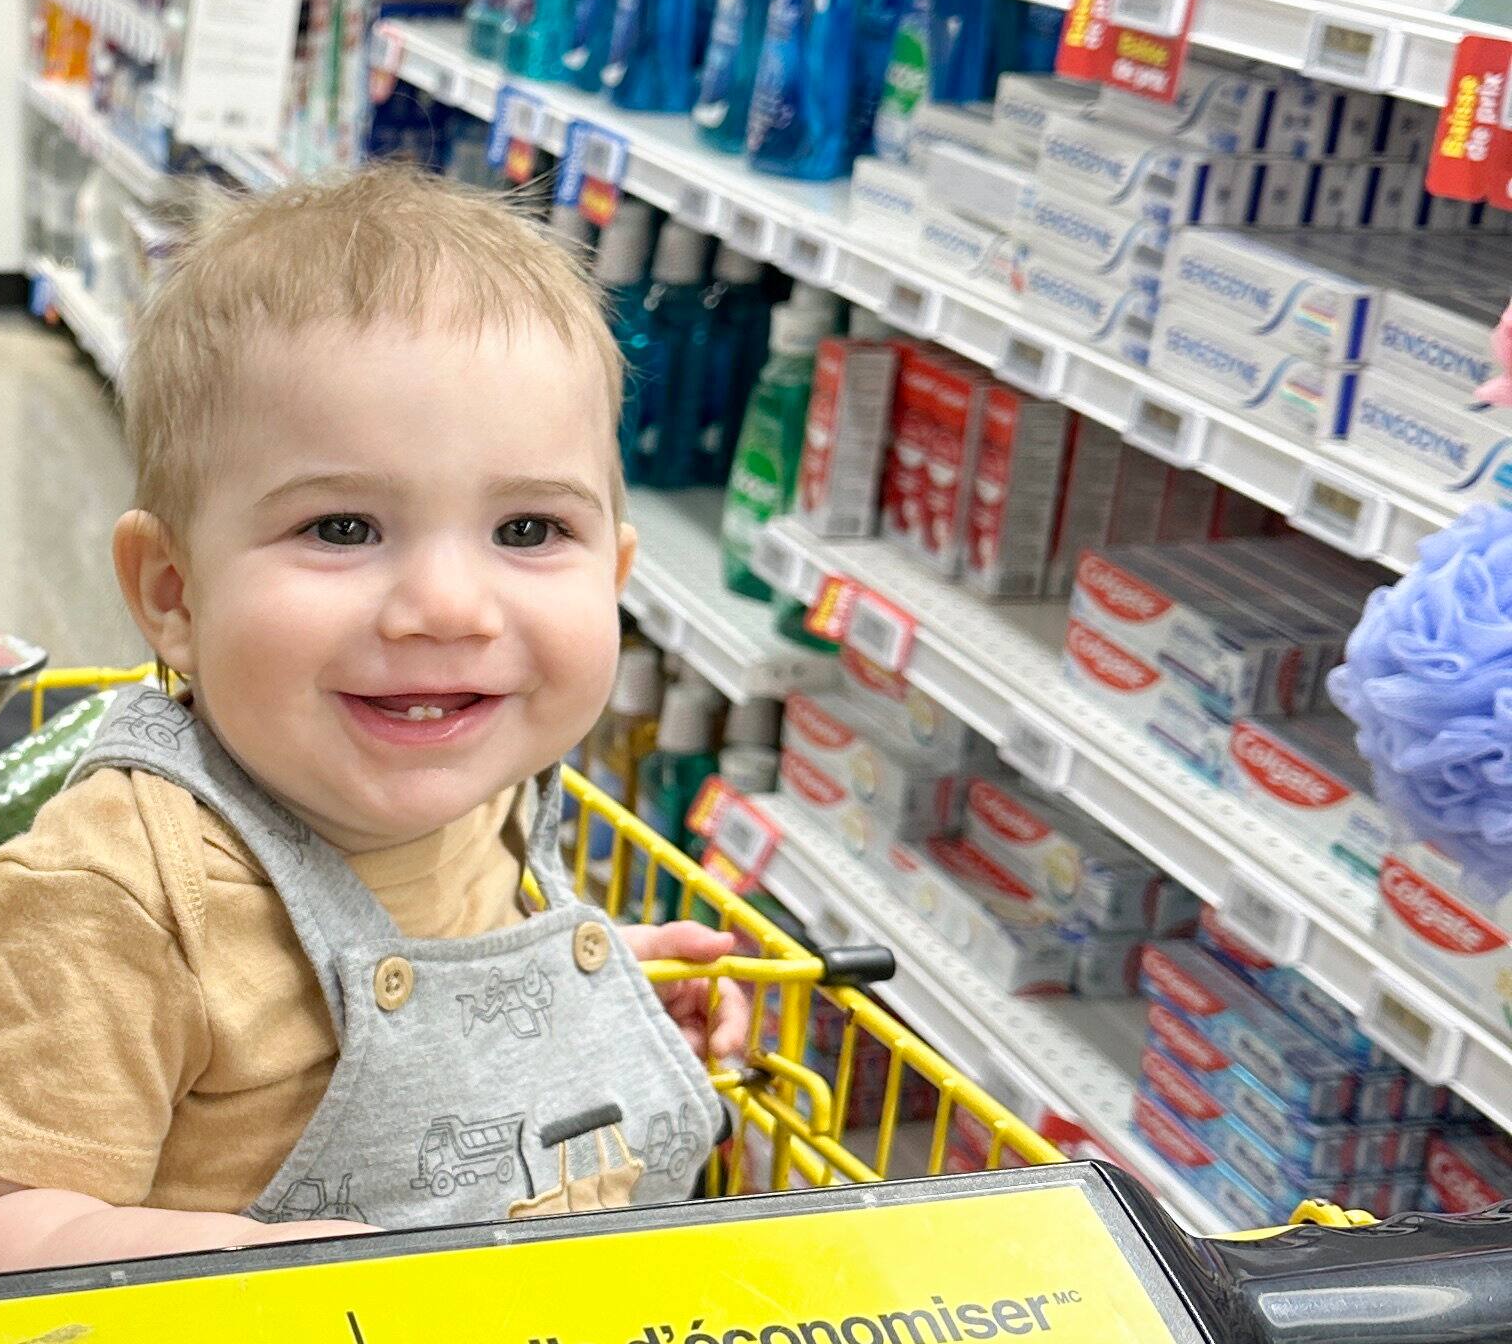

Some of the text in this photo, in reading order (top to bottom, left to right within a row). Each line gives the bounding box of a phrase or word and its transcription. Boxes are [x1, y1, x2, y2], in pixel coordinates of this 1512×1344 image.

[1441, 74, 1480, 158] Baisse
[1466, 70, 1504, 162] de prix
[1235, 729, 1330, 804] Colgate
[1387, 864, 1485, 952] Colgate
